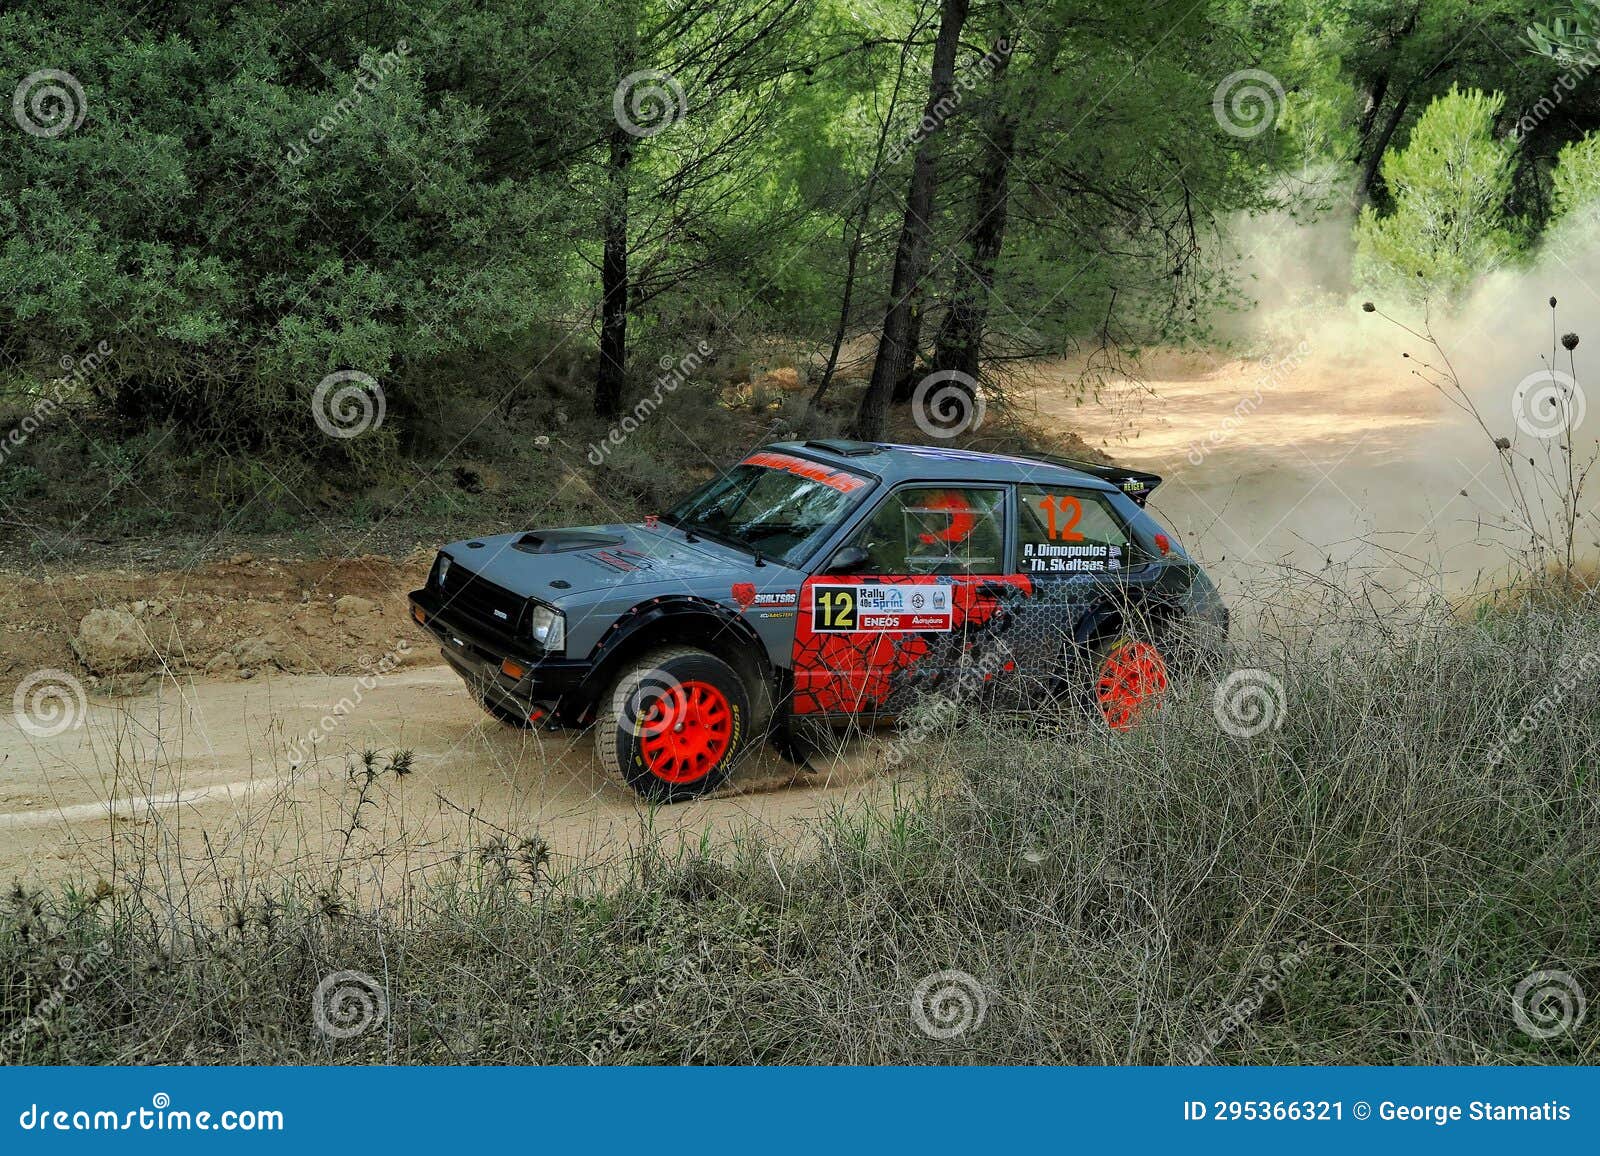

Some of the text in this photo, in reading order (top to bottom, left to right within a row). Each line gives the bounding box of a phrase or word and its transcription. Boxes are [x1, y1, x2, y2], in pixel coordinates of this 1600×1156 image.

[1039, 493, 1085, 542] 12
[860, 588, 885, 600] Rally
[818, 591, 853, 627] 12
[873, 599, 903, 610] Sprint
[864, 617, 900, 627] ENEOS
